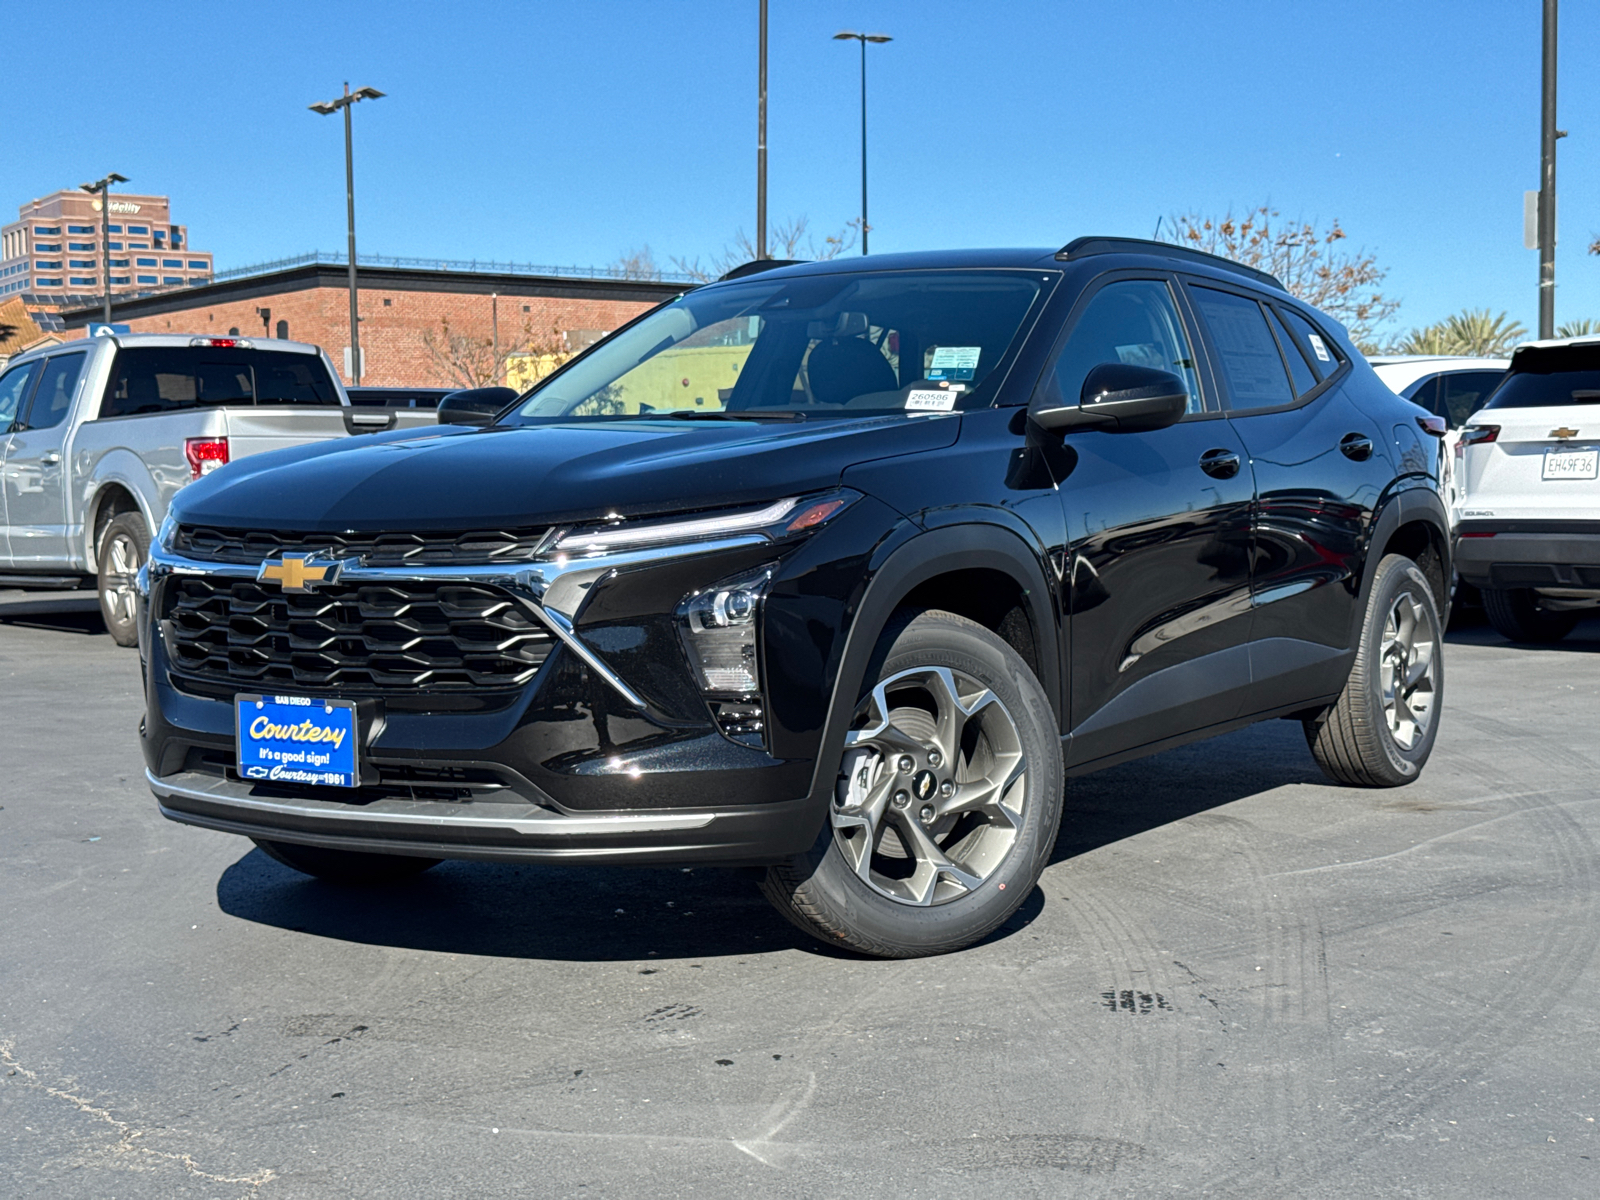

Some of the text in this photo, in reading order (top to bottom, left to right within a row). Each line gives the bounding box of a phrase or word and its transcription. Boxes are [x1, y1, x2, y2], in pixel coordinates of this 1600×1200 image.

[107, 201, 141, 214] idelity
[1547, 458, 1593, 472] EH49F36
[274, 695, 311, 706] SAN DIEGO
[249, 715, 347, 750] Courtesy
[259, 747, 330, 767] It's a good sign!
[269, 763, 319, 785] Courtesy
